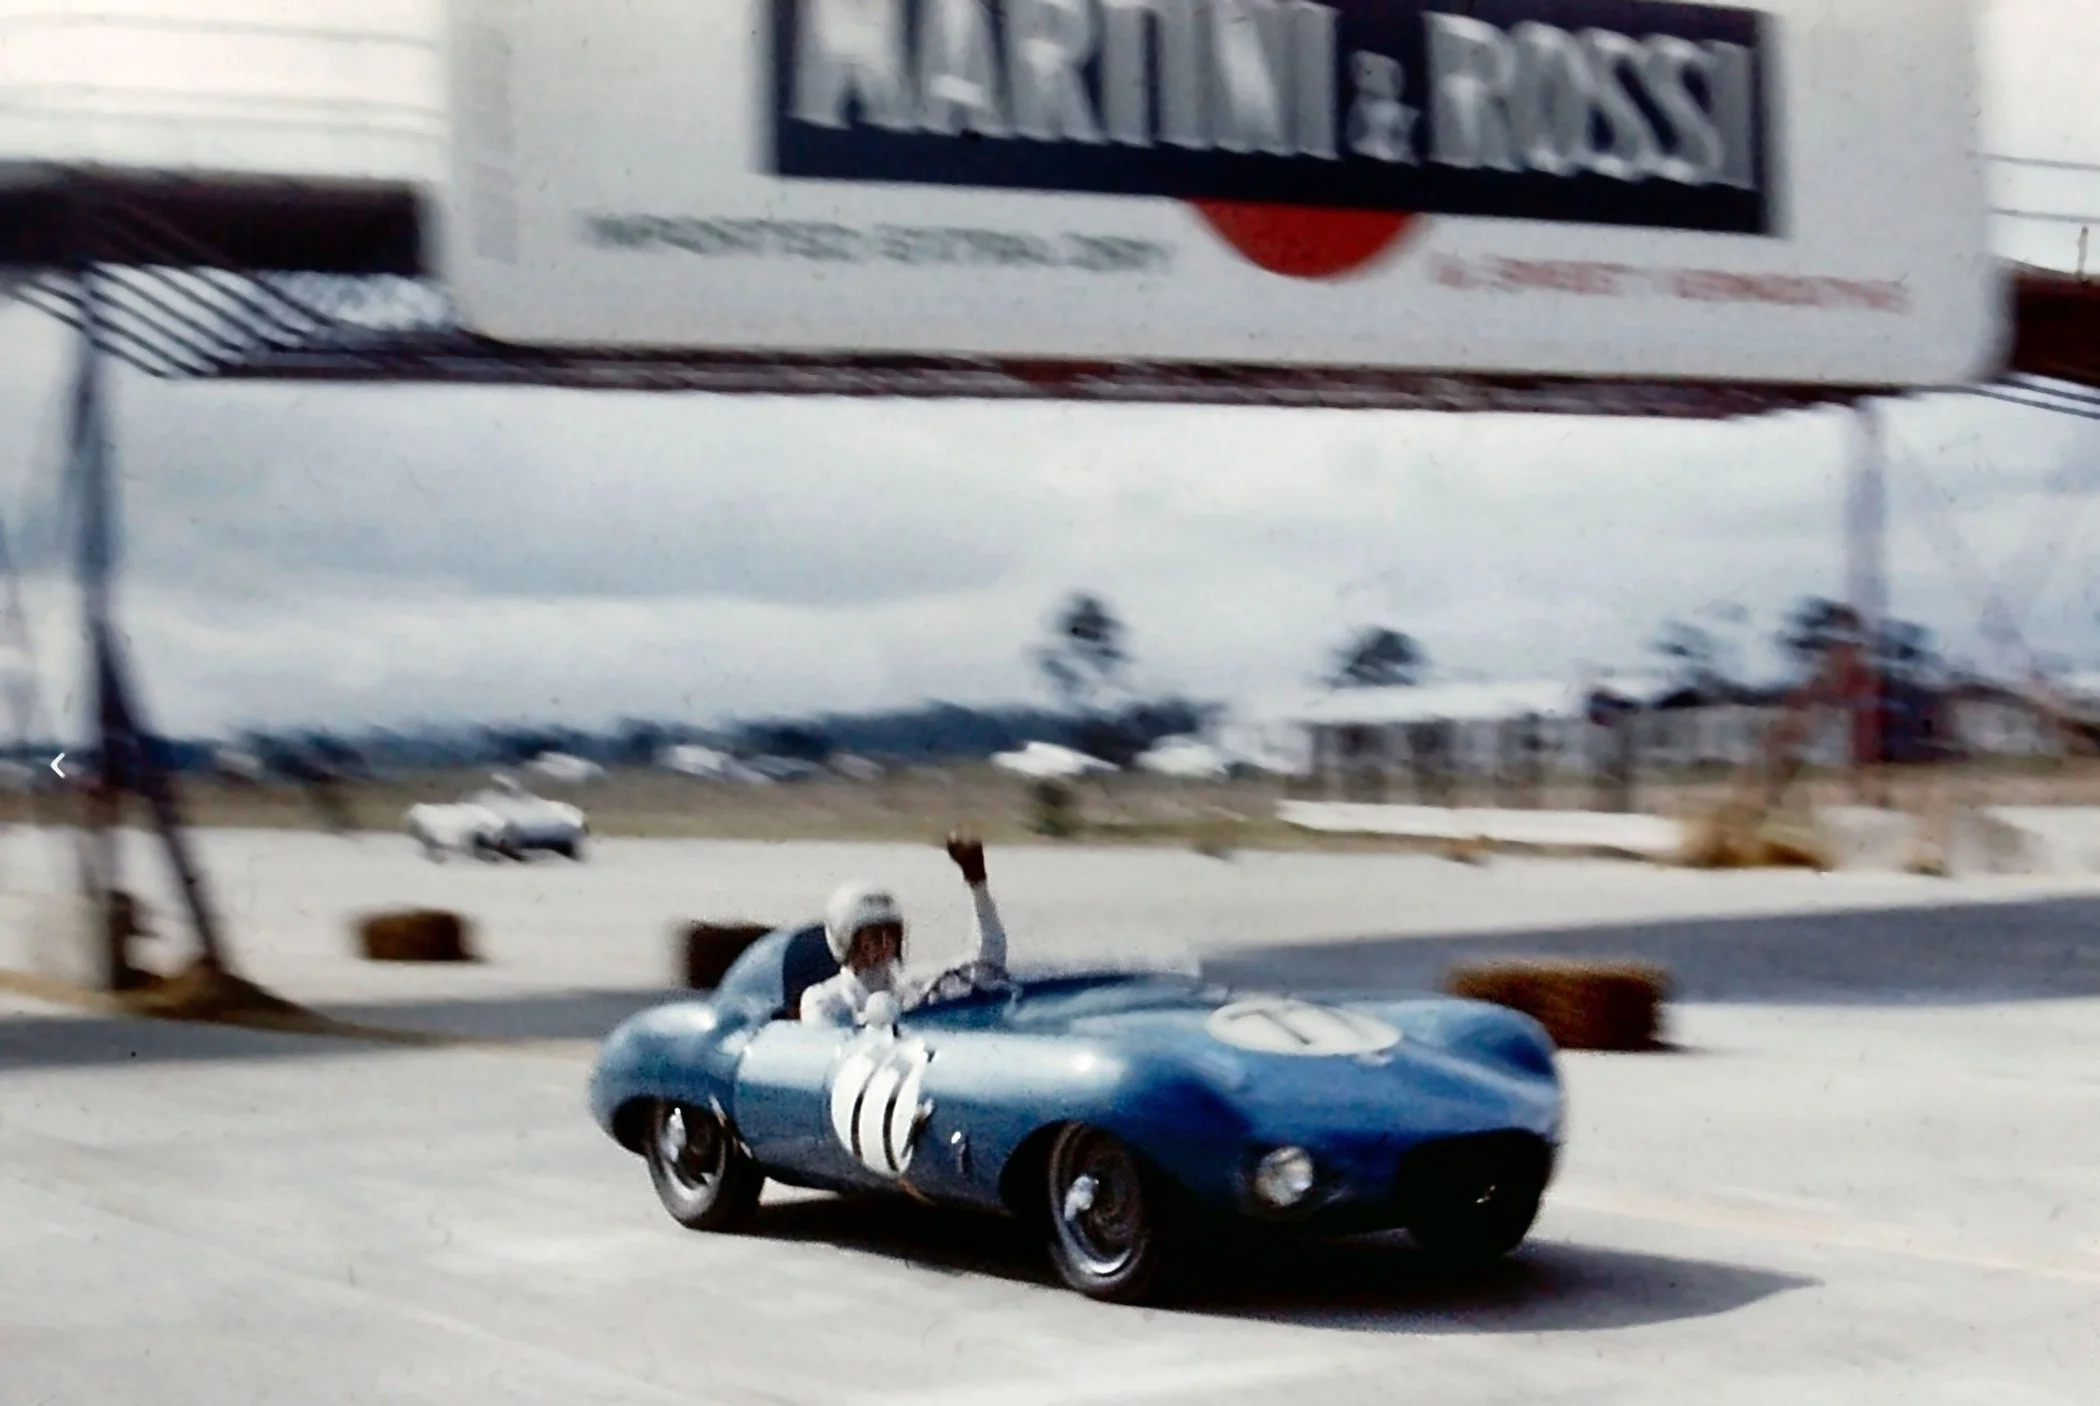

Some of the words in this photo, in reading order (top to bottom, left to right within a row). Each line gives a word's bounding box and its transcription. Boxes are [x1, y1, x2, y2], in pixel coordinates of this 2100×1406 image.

[790, 0, 1338, 160] MARTINI
[1346, 50, 1420, 166] &
[1424, 11, 1755, 190] ROSSI
